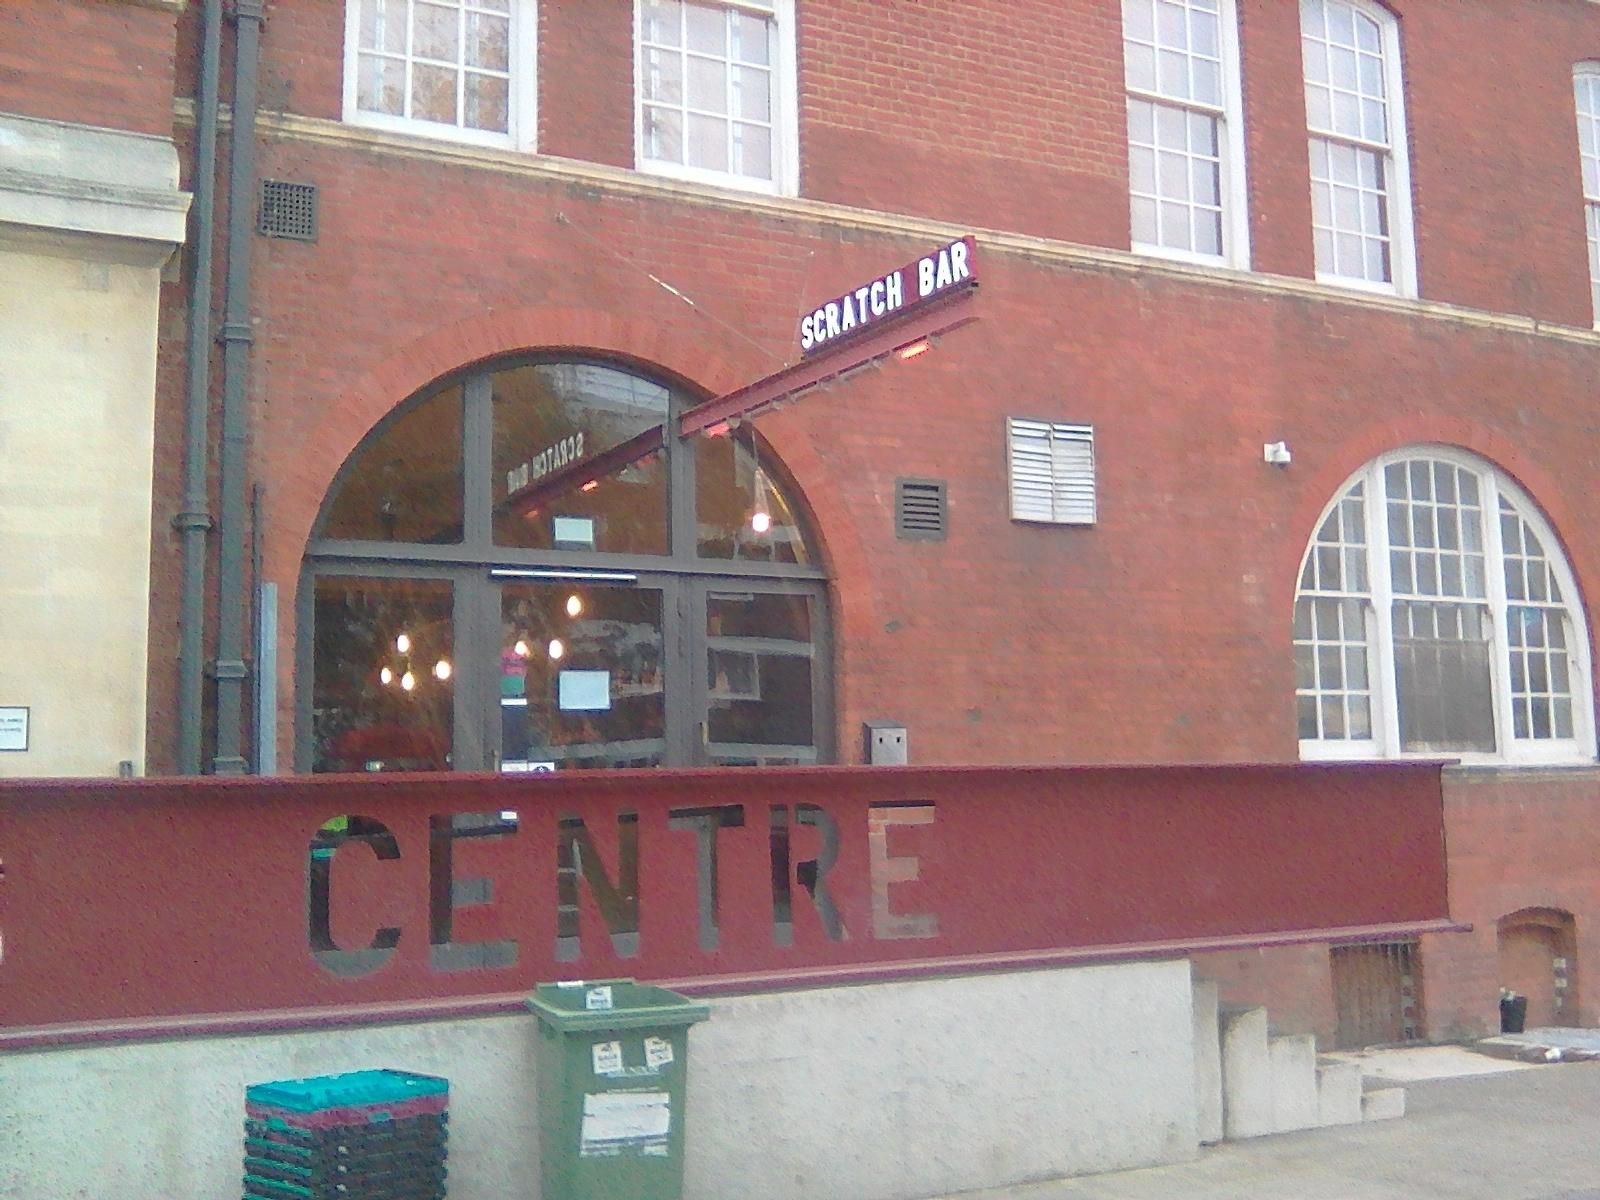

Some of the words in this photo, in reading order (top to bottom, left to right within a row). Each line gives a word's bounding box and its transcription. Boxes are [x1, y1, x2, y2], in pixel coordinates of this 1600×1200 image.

[801, 271, 903, 349] SCRATCH
[918, 241, 969, 297] BAR
[309, 800, 940, 978] CENTRE
